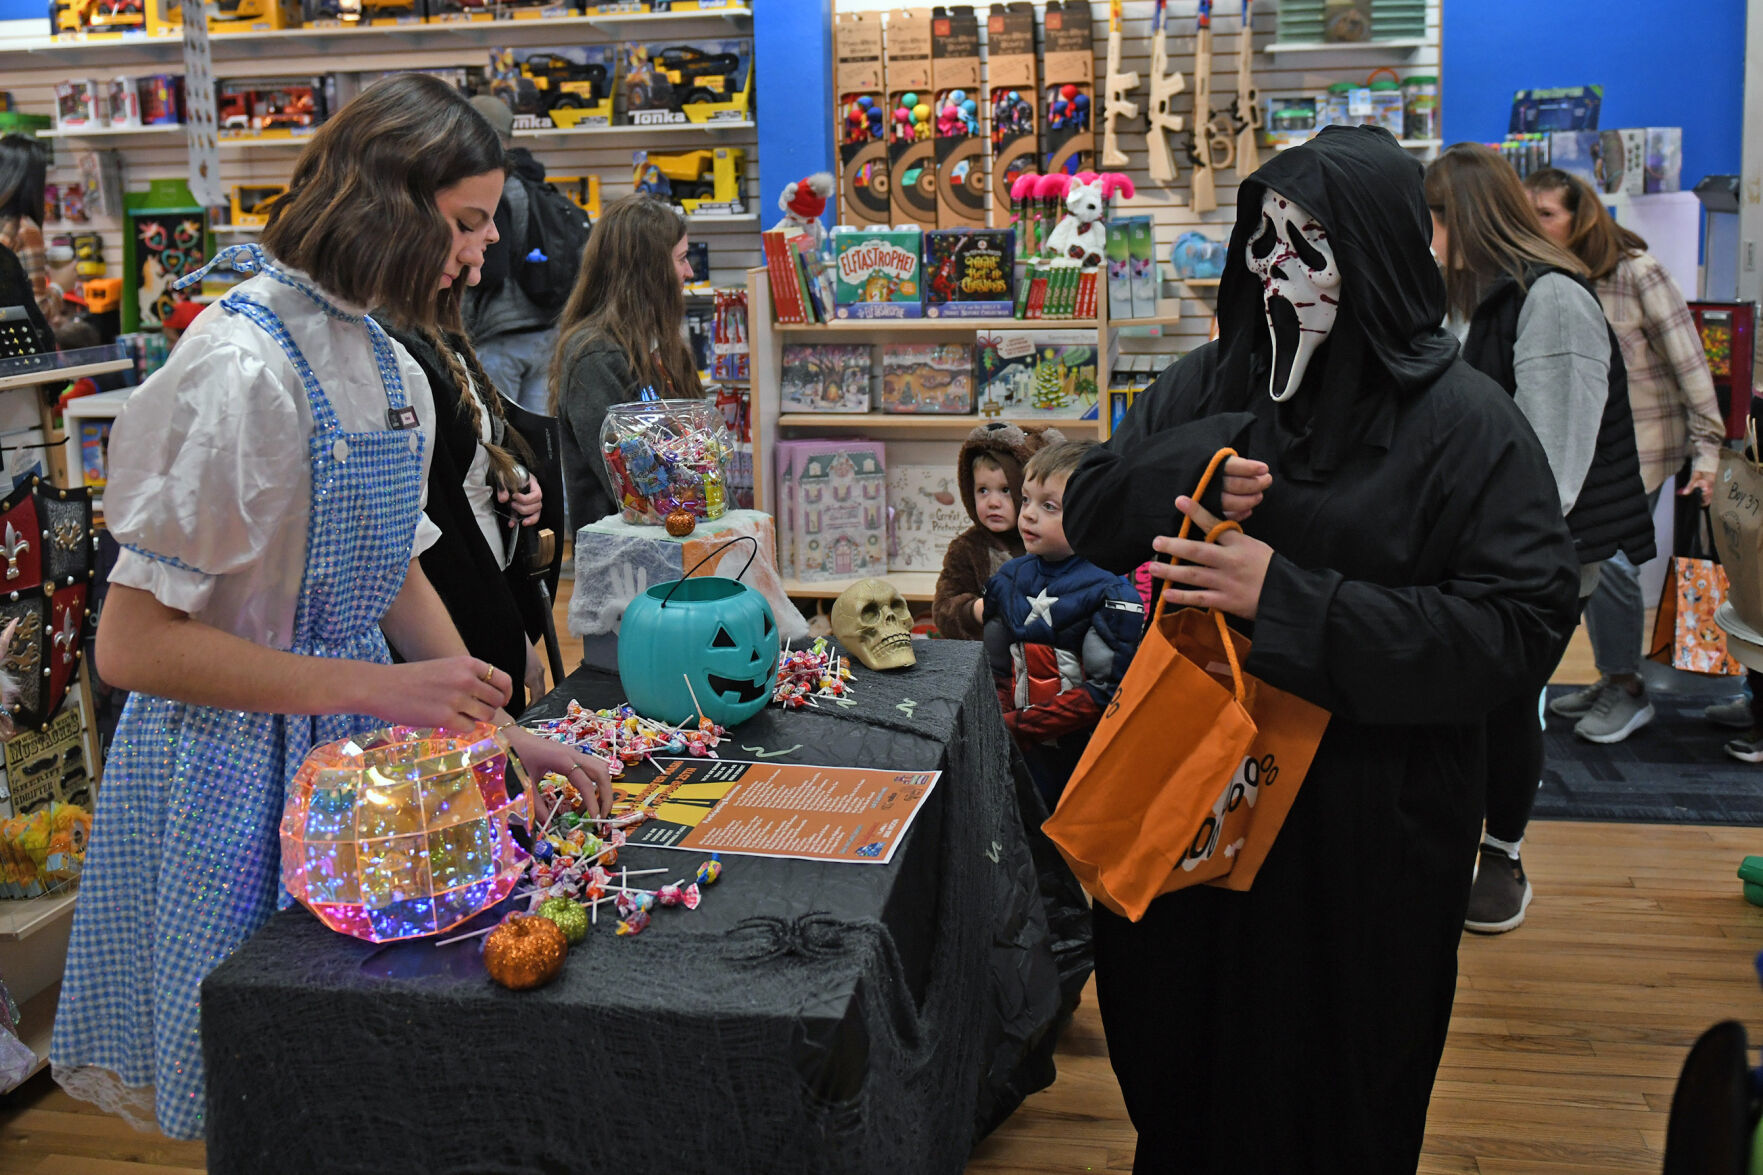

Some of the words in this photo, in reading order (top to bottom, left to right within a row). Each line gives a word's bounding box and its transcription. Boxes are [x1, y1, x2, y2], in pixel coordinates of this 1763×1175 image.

[513, 115, 553, 129] nka
[628, 108, 686, 125] Tonka
[840, 247, 915, 277] ELFTASTROPHE!
[9, 713, 80, 766] MUSTACHES
[652, 780, 683, 805] OCTOBER
[675, 767, 697, 781] 25TH
